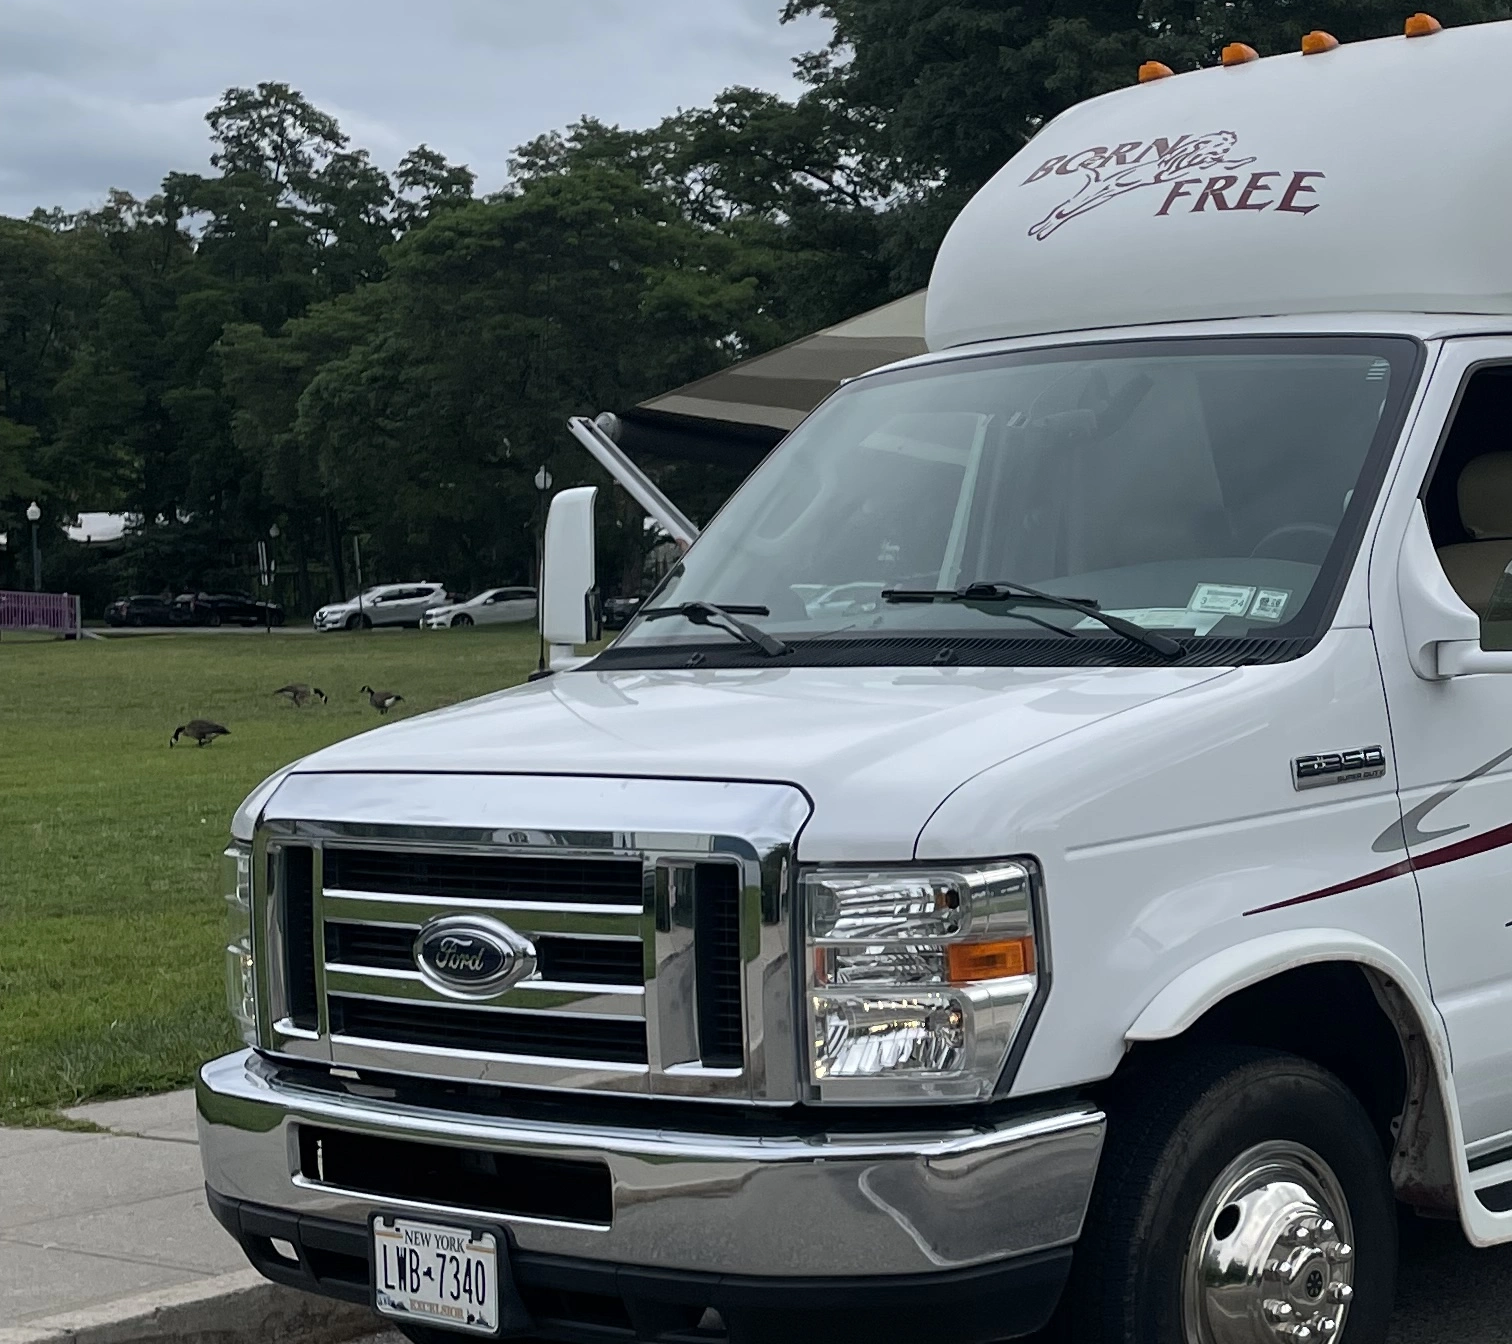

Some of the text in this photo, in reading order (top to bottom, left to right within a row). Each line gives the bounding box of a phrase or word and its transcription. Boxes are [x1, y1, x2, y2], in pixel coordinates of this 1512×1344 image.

[1019, 133, 1189, 187] BORN
[1154, 169, 1326, 217] FREE
[435, 936, 486, 971] Ford
[404, 1229, 466, 1254] NEW YORK
